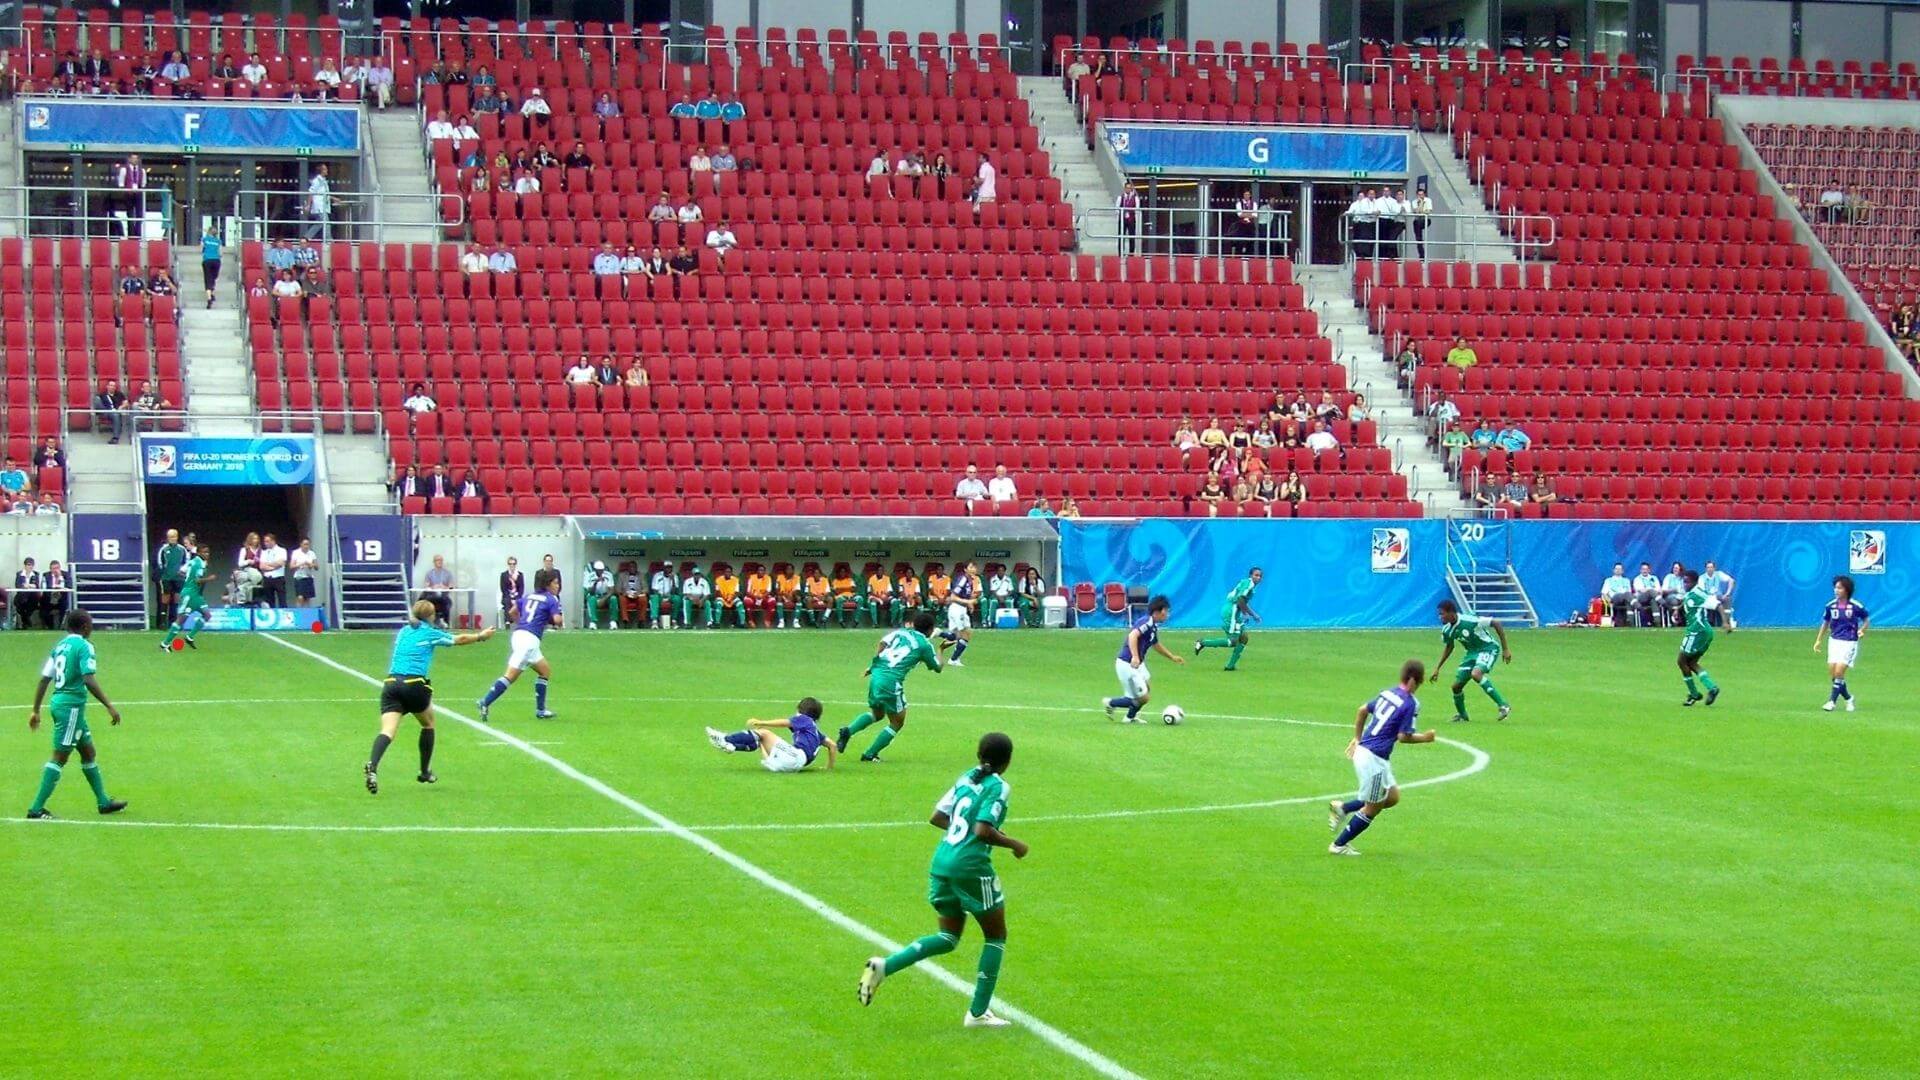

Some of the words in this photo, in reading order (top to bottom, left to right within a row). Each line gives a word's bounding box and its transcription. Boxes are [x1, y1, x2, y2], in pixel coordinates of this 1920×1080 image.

[184, 113, 200, 139] F
[1248, 137, 1269, 163] G
[183, 463, 224, 471] GERMANY
[262, 453, 291, 461] WORLD
[1461, 523, 1484, 541] 20
[91, 539, 120, 561] 18
[354, 540, 382, 561] 19
